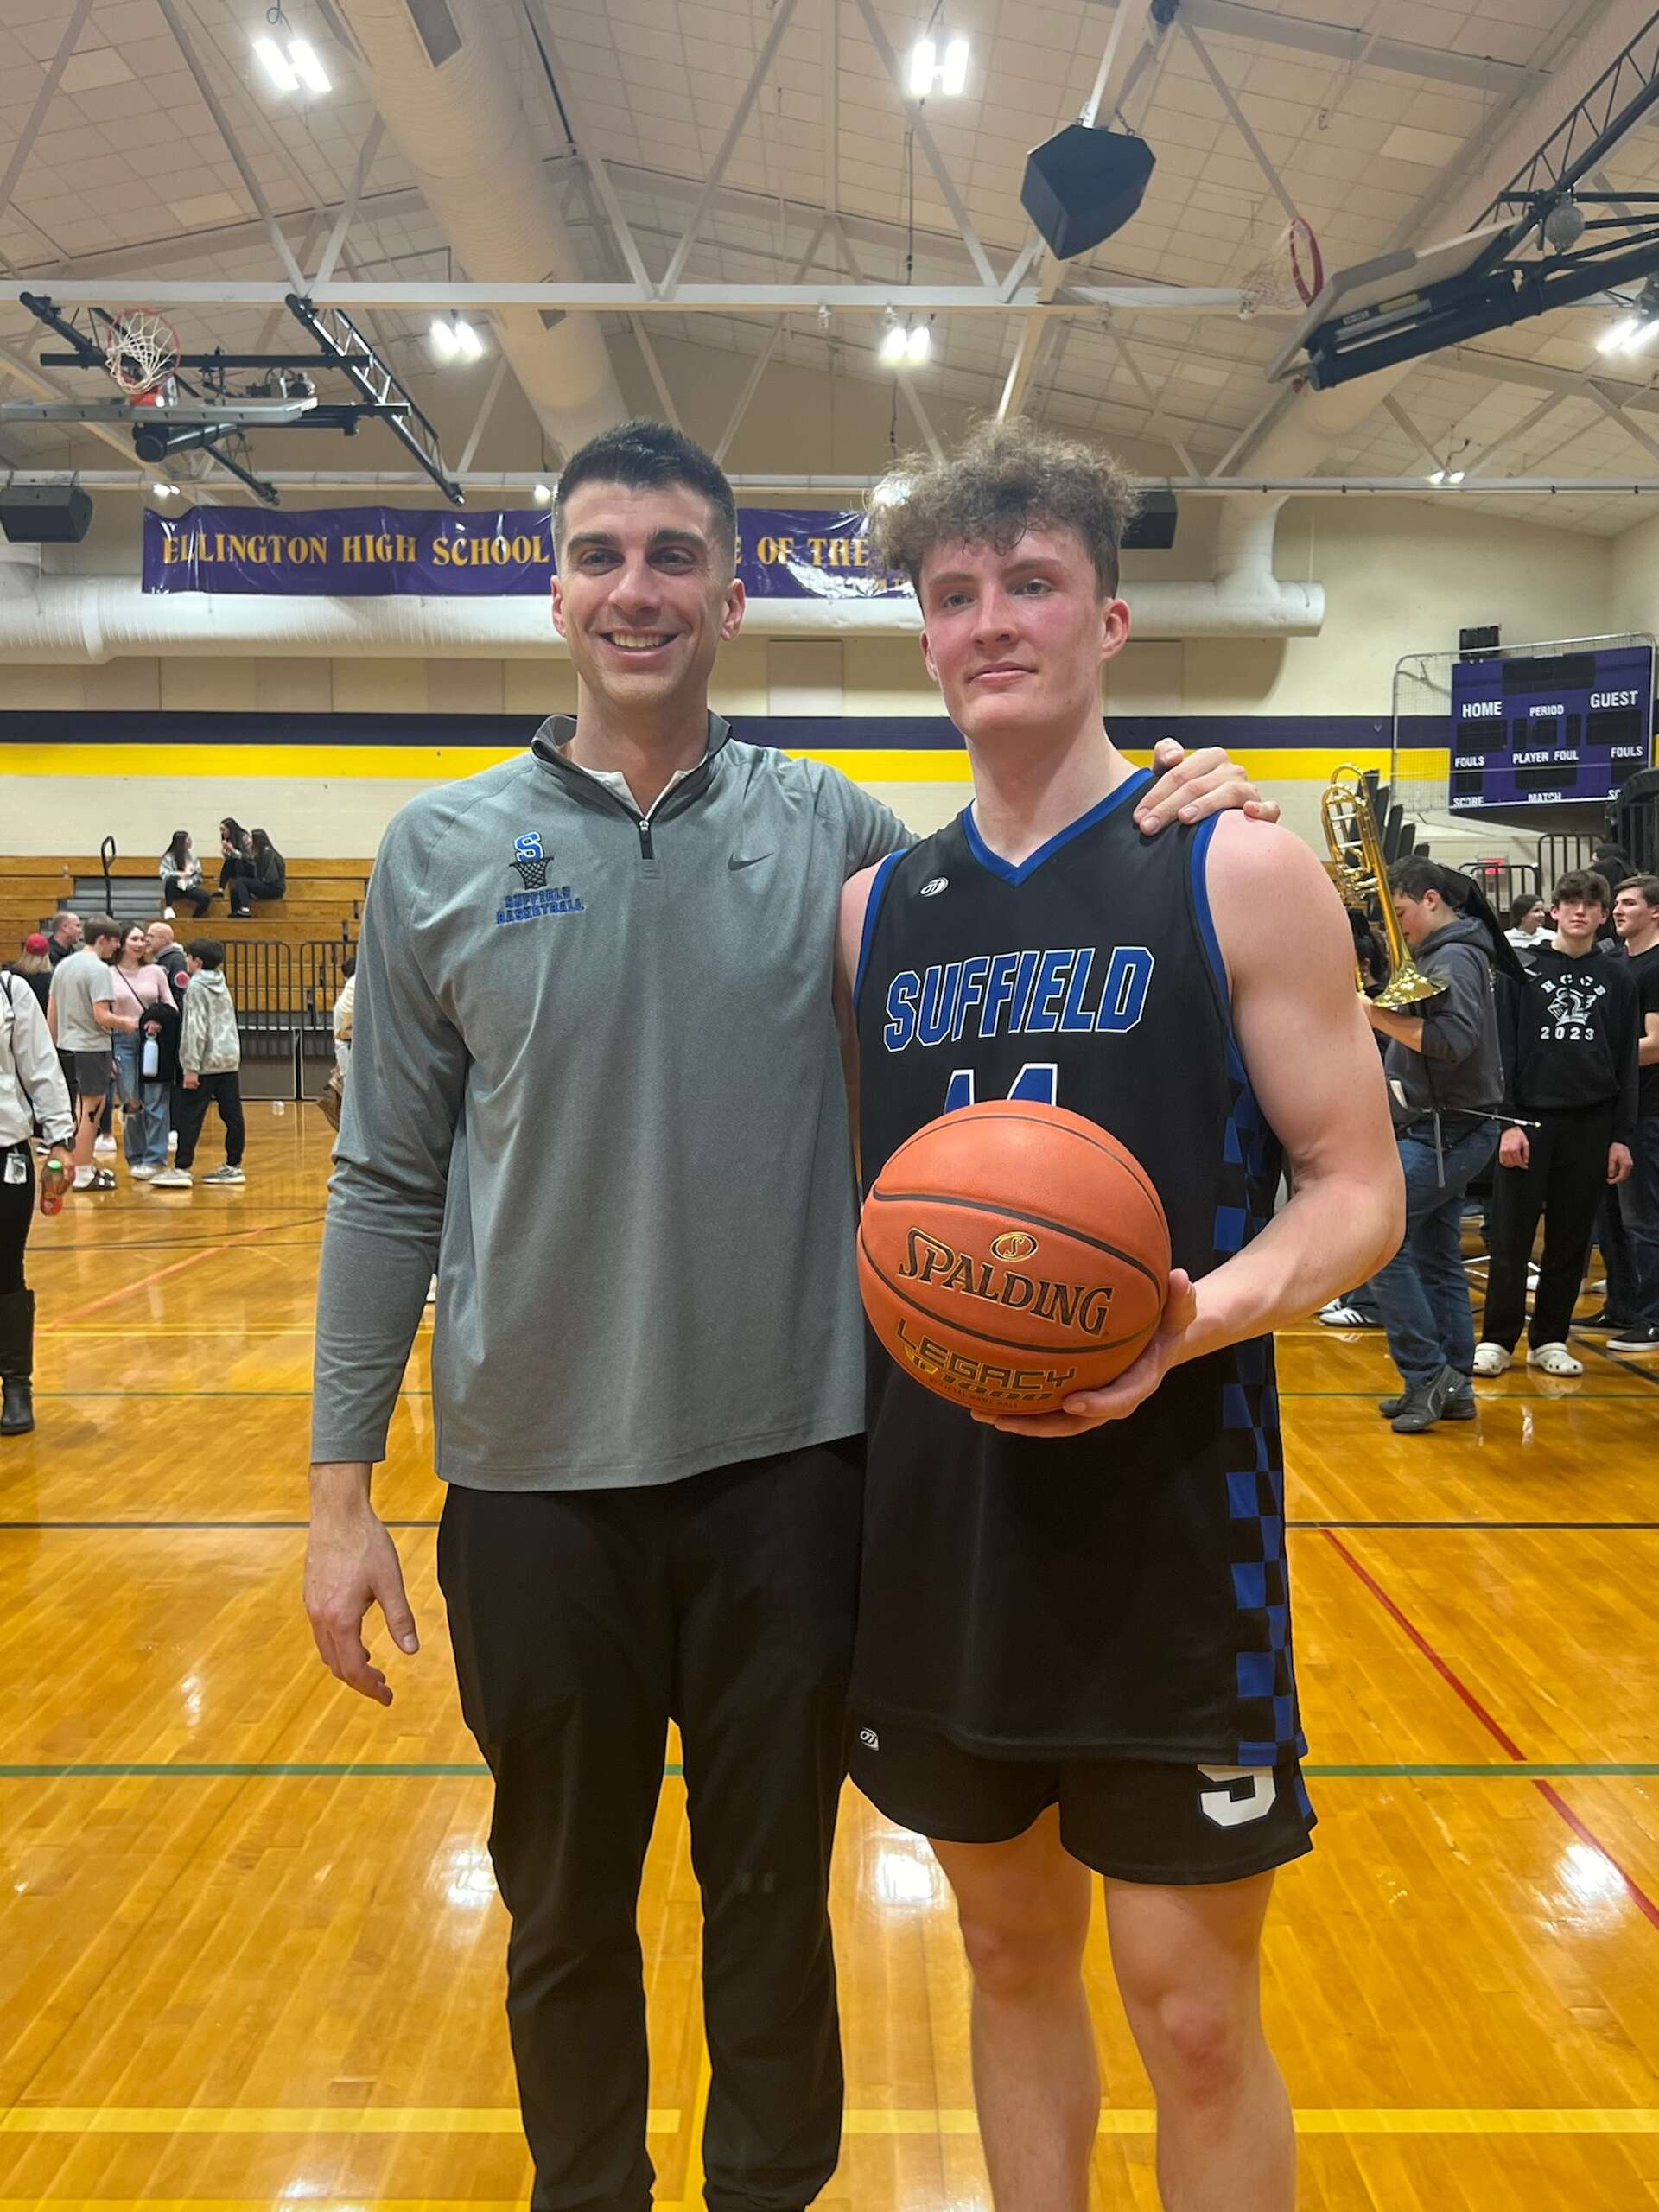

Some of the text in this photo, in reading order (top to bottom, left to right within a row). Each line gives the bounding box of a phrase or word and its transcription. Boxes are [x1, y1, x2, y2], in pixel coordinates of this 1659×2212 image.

[162, 532, 328, 564] ELLINGTON
[341, 533, 416, 564] HIGH
[432, 535, 550, 567] SCHOOL
[756, 536, 794, 565] OF
[806, 537, 872, 567] THE
[1590, 690, 1639, 709] GUEST
[1462, 701, 1503, 719] HOME
[1529, 704, 1565, 717] PERIOD
[1512, 749, 1580, 765] PLAYER FOUL
[1610, 746, 1643, 759] FOULS
[1454, 755, 1485, 769] FOULS
[513, 830, 544, 863] S
[883, 945, 1155, 1052] SUFFIELD
[1540, 1026, 1595, 1041] 2023
[899, 1226, 1114, 1338] SPALDING
[896, 1318, 1077, 1389] LEGACY
